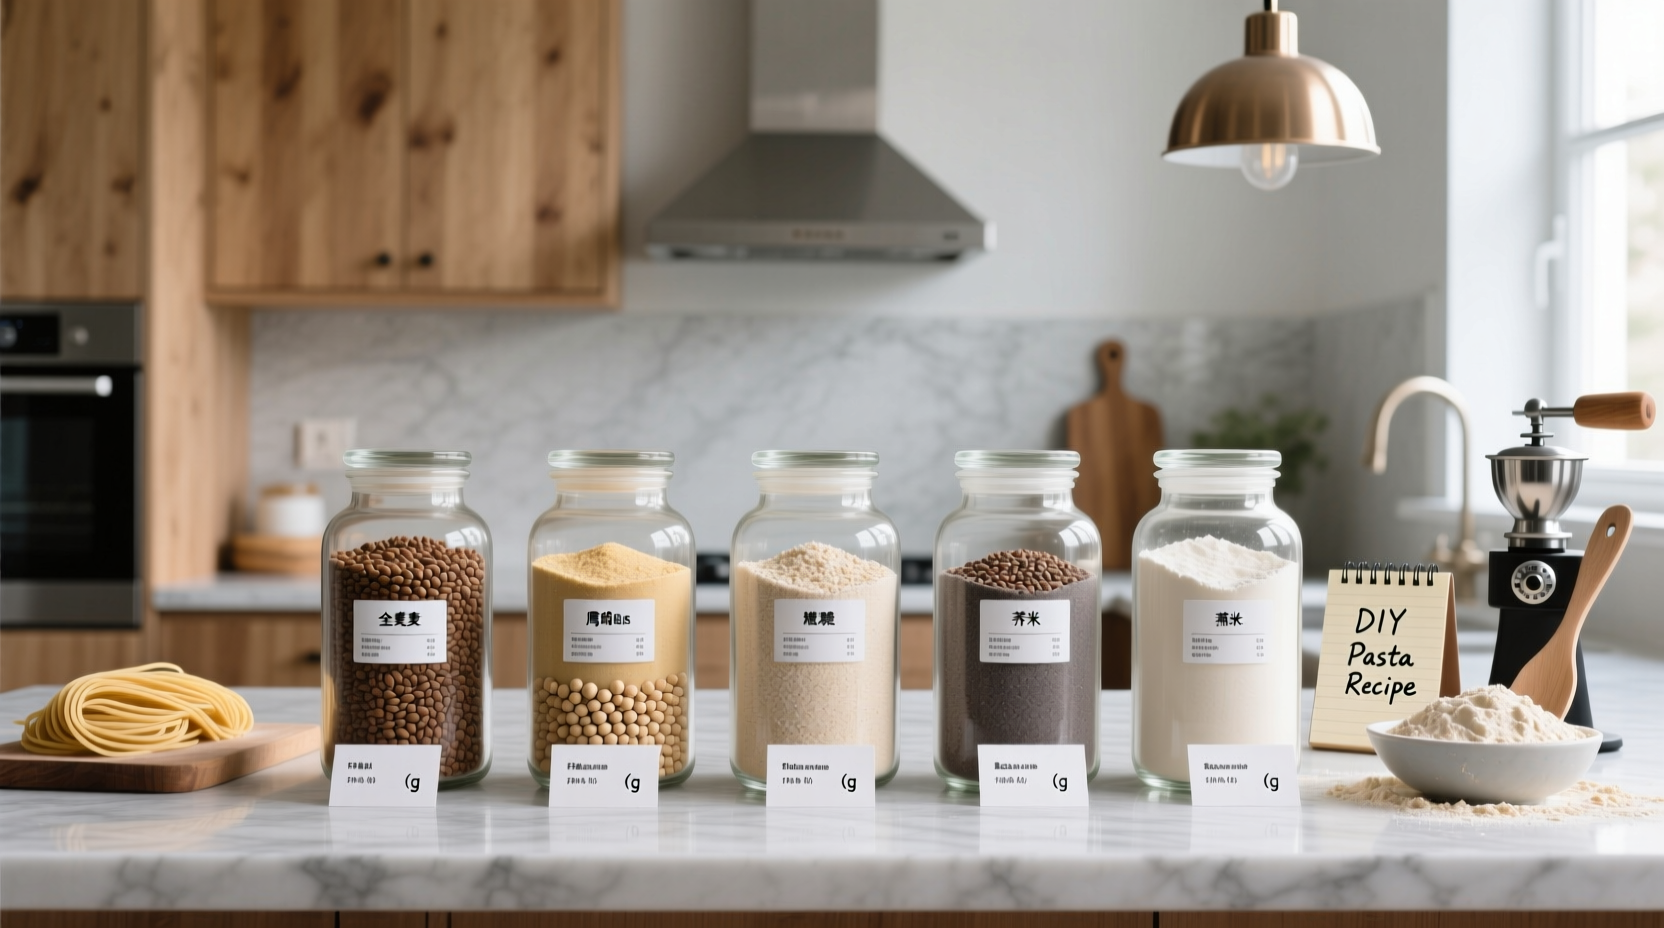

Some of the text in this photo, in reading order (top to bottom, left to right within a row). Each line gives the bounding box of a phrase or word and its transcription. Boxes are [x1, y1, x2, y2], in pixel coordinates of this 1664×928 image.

[1355, 607, 1407, 635] DIY
[1347, 641, 1414, 667] Pasta
[1345, 671, 1417, 705] Recipe
